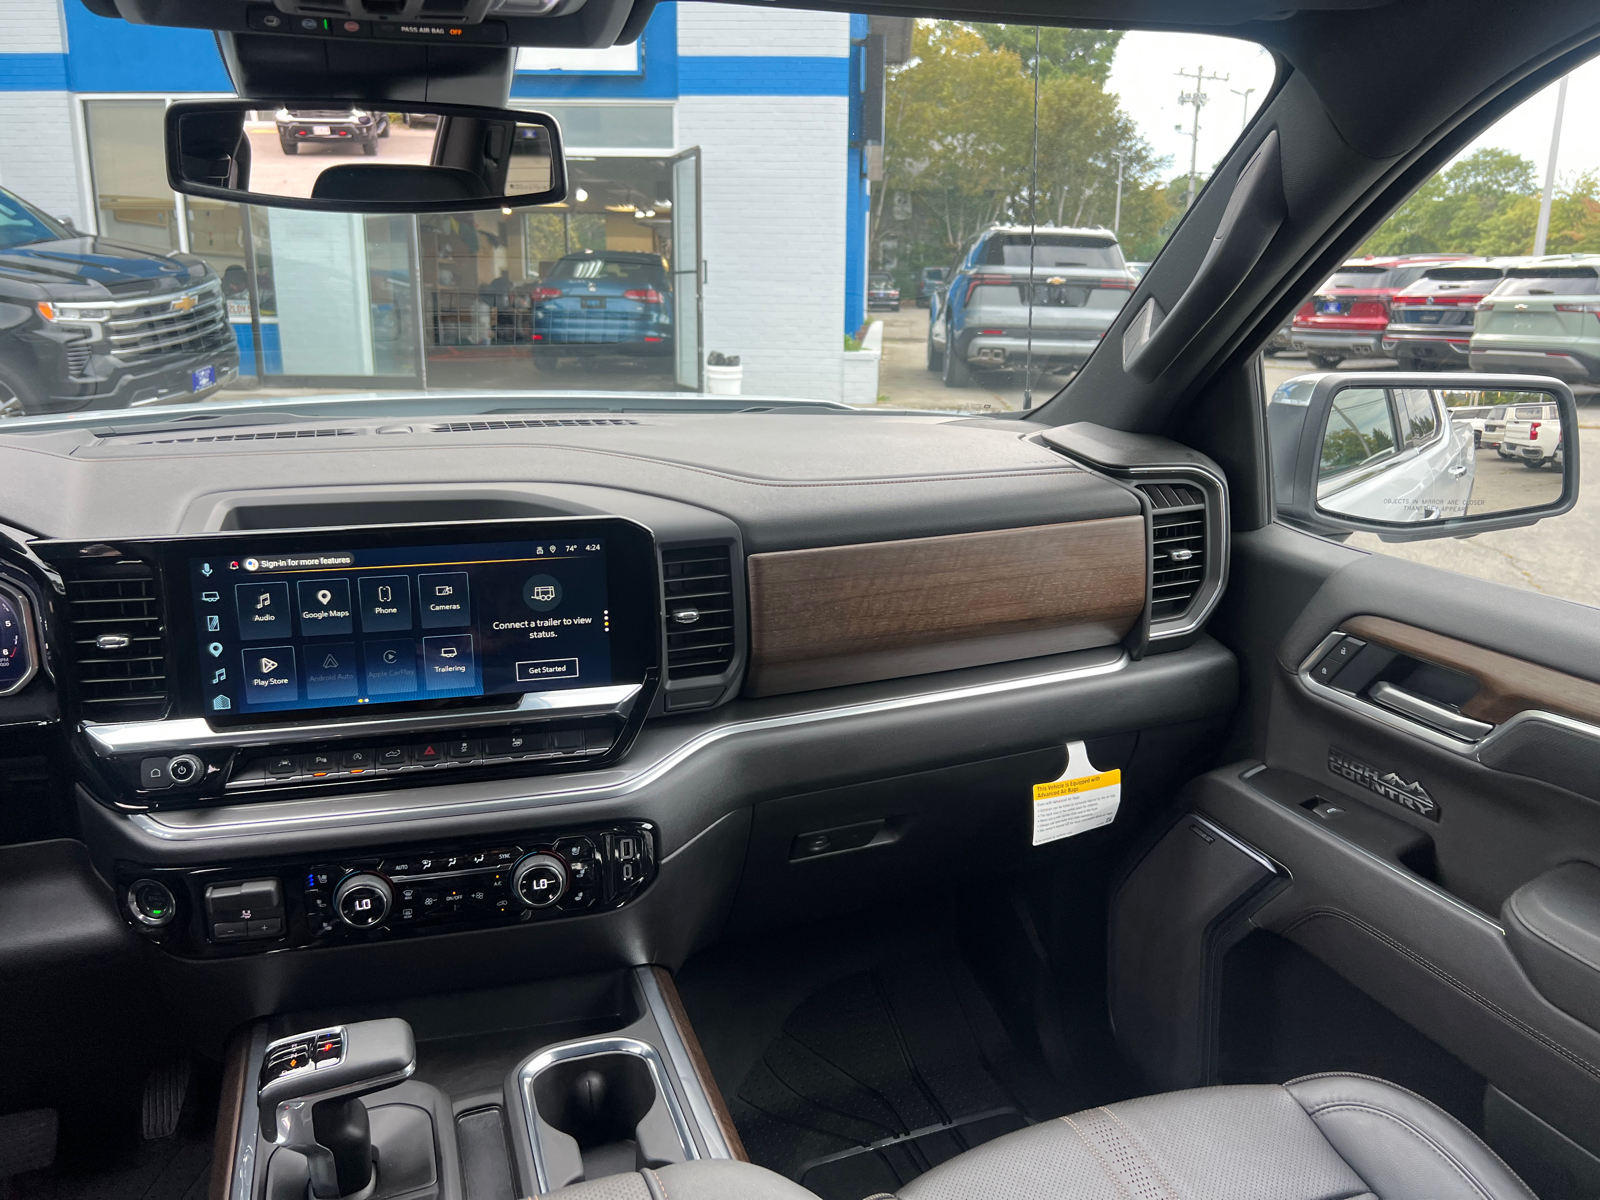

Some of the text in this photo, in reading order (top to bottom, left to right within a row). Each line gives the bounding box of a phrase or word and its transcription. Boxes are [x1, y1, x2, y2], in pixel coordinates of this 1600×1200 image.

[261, 559, 287, 569] Sign-in
[320, 556, 351, 565] features
[430, 603, 460, 611] Cameras
[302, 610, 349, 620] Google Maps
[492, 620, 528, 630] Connect
[536, 618, 561, 627] trailer
[563, 617, 572, 625] to
[529, 630, 558, 639] status.
[433, 665, 465, 673] Trailering
[541, 665, 566, 673] Started
[309, 674, 336, 682] Android
[368, 671, 387, 679] Apple
[254, 677, 288, 687] Play Store
[1328, 750, 1379, 781] HIGH
[1070, 778, 1090, 787] Equipped
[1329, 761, 1433, 815] COUNTRY
[1037, 790, 1059, 798] Advanced
